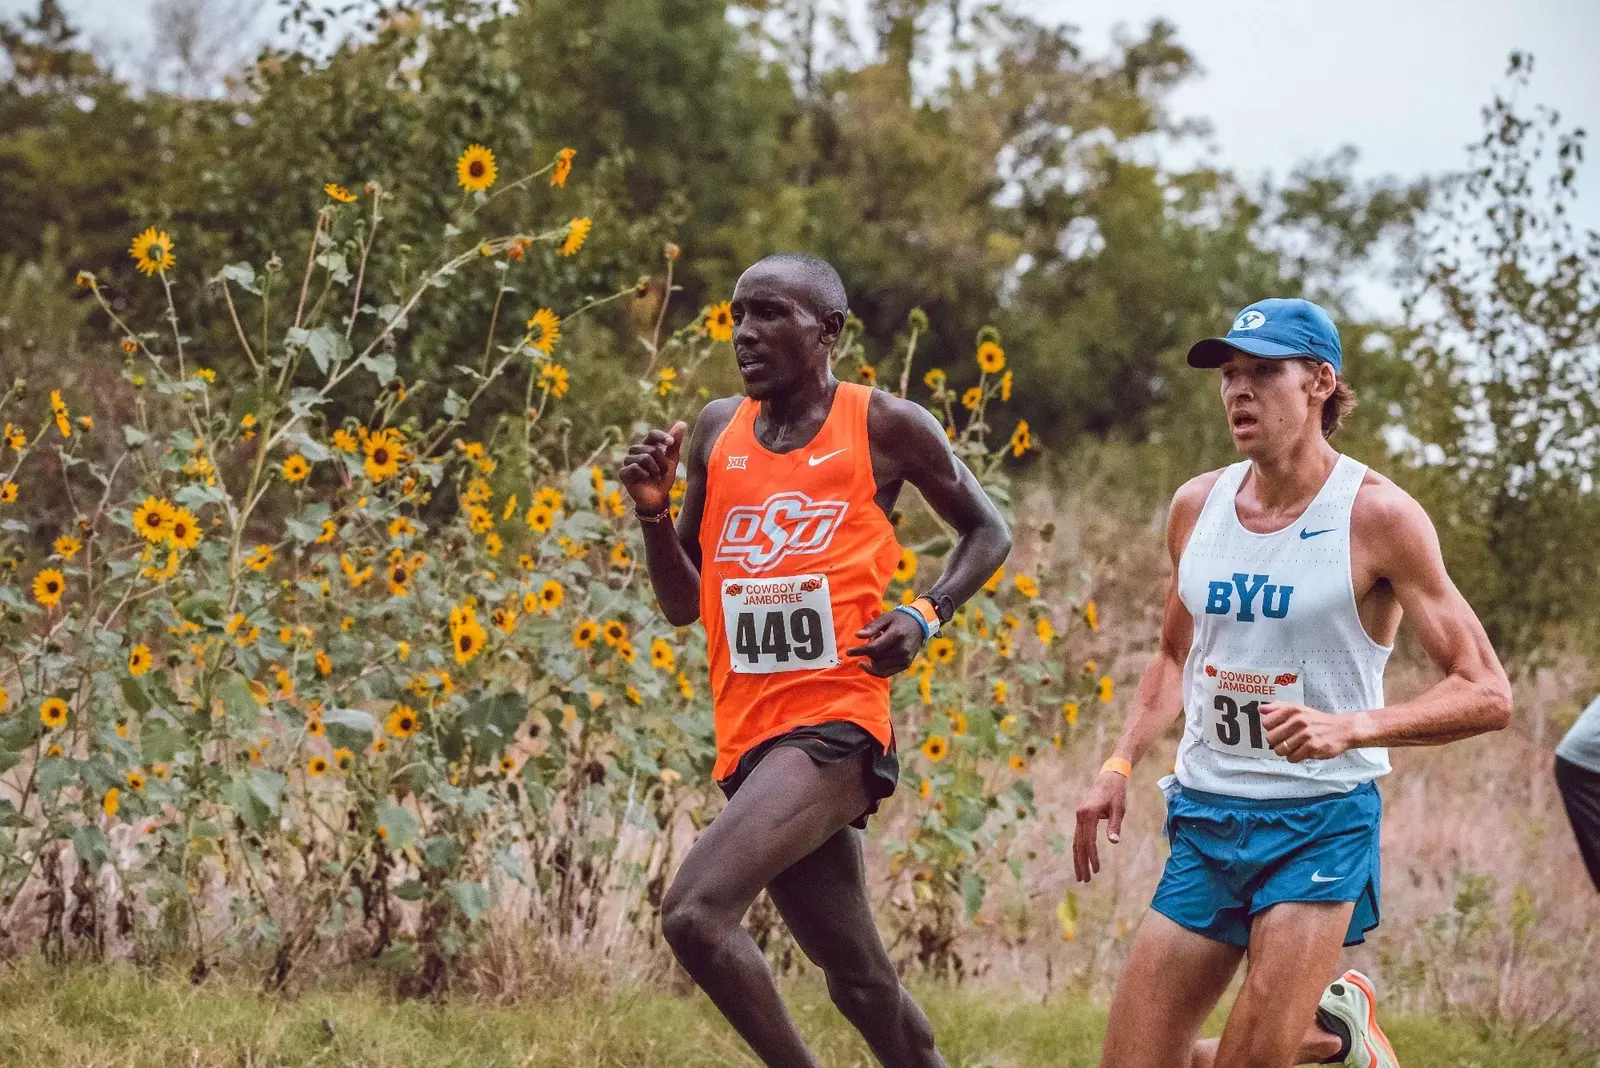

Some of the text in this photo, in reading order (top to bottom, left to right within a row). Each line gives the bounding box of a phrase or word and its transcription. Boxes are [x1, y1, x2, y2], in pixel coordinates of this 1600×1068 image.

[717, 495, 844, 569] OSU
[743, 593, 803, 605] JAMBOREE
[746, 583, 795, 595] COWBOY
[1205, 573, 1294, 622] BYU
[736, 608, 824, 663] 449
[1217, 681, 1276, 696] JAMBOREE
[1220, 671, 1270, 685] COWBOY
[1213, 694, 1275, 750] 31
